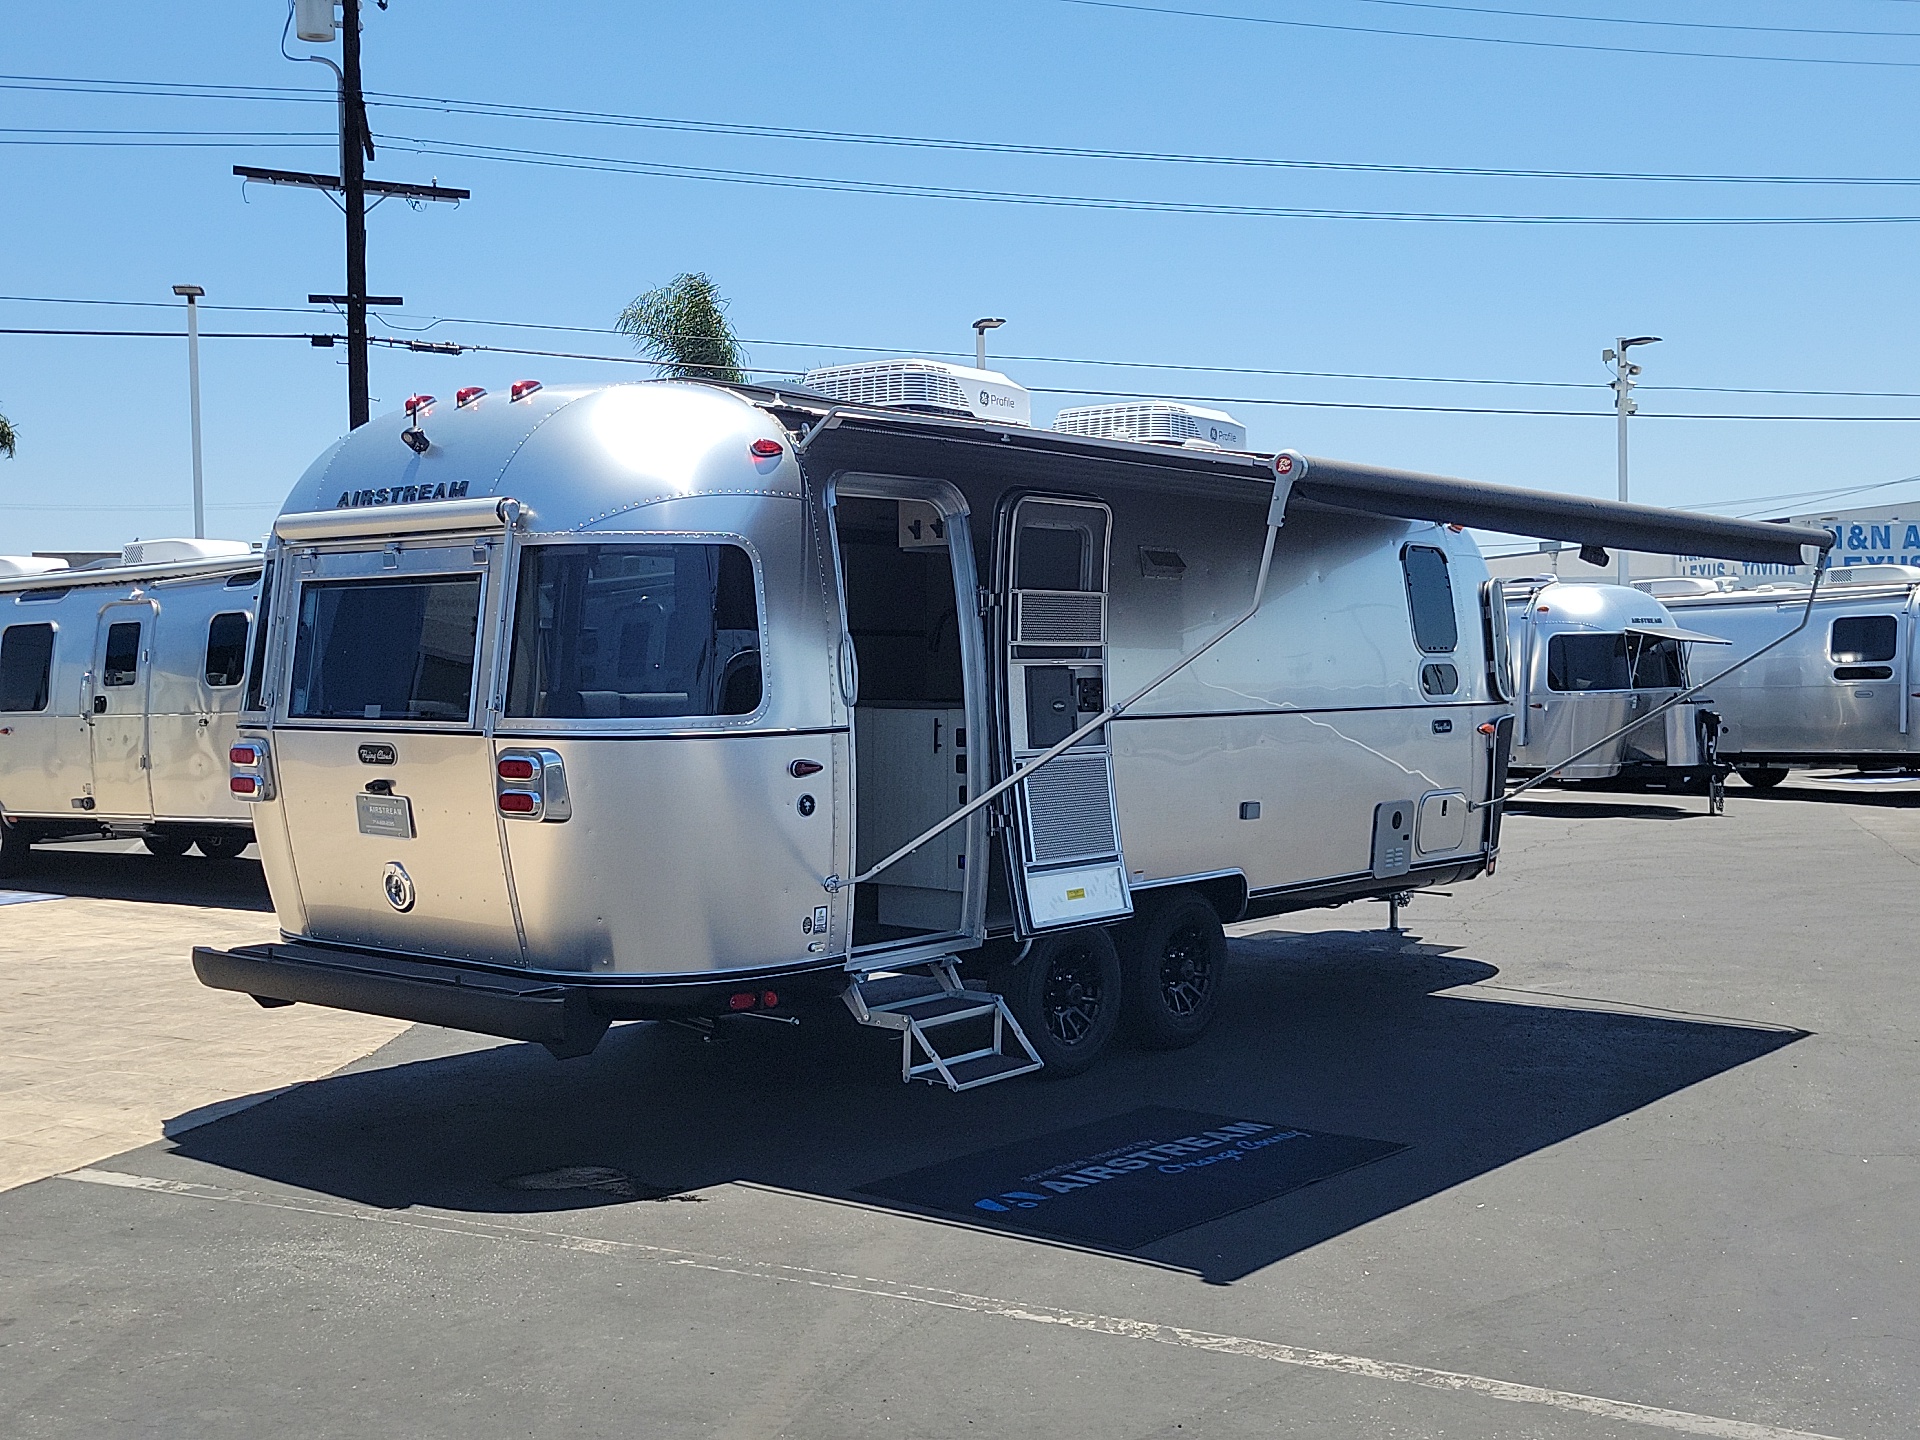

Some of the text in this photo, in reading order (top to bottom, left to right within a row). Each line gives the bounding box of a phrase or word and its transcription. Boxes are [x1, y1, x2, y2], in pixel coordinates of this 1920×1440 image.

[990, 394, 1015, 409] Profile
[1218, 430, 1237, 442] Profile
[336, 480, 470, 508] AIRSTREAM
[369, 806, 402, 815] AIRSTREAM
[1039, 1120, 1275, 1194] AIRSTREAM
[1157, 1149, 1245, 1175] Orange
[1235, 1129, 1313, 1150] County
